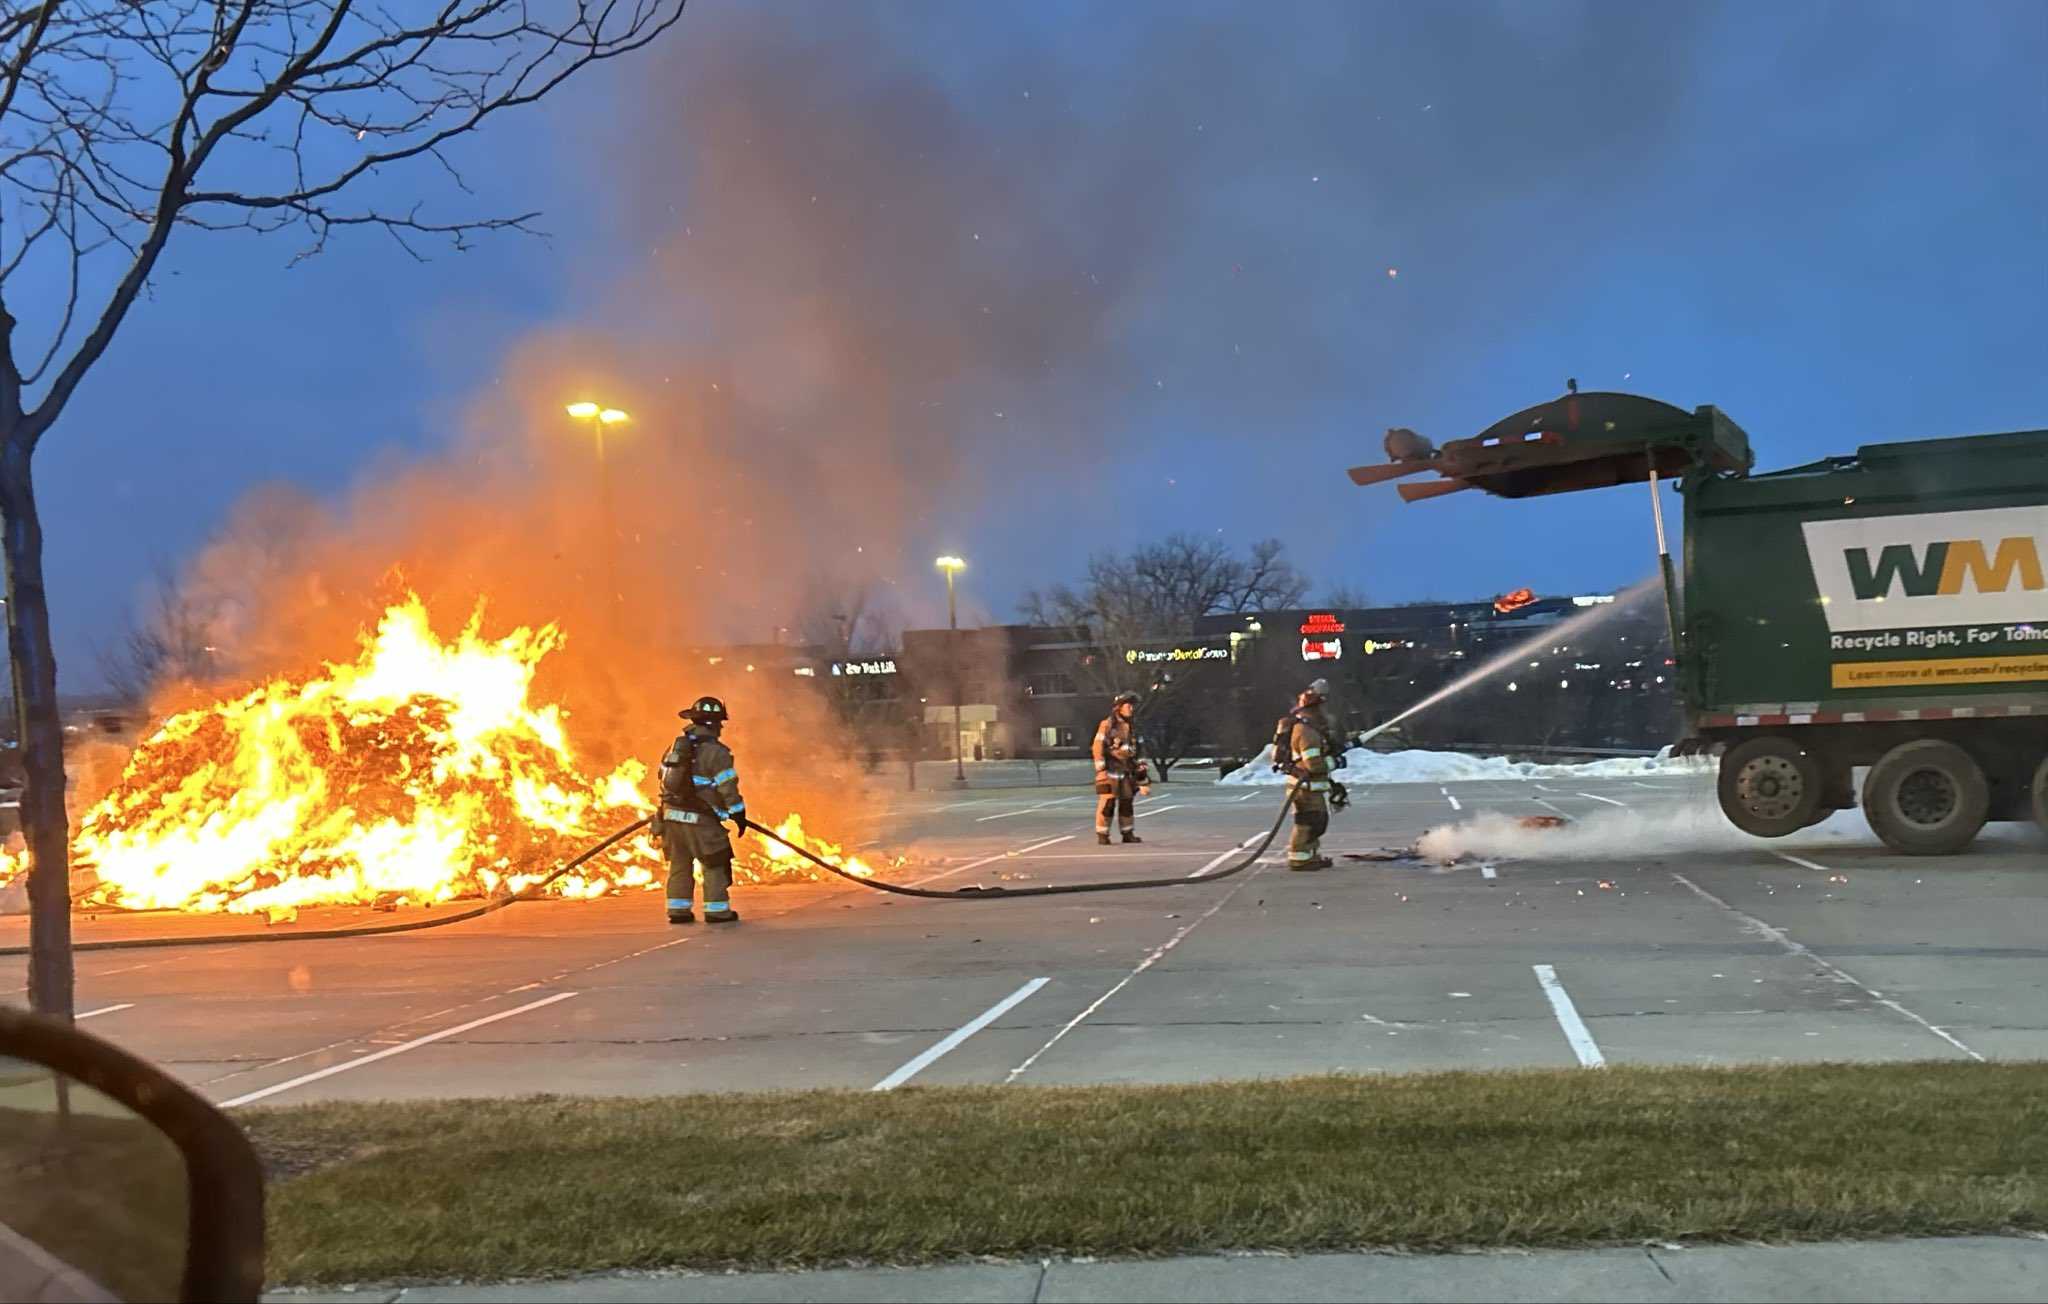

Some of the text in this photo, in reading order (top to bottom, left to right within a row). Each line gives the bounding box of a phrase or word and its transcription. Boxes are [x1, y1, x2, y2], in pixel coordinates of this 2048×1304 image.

[1843, 536, 2046, 600] WM
[1831, 632, 1900, 651] Recycle
[1906, 630, 1961, 648] Right,
[1967, 628, 1999, 643] For
[1848, 669, 1882, 681] Learn
[1885, 668, 1917, 679] more
[1921, 667, 1933, 678] at
